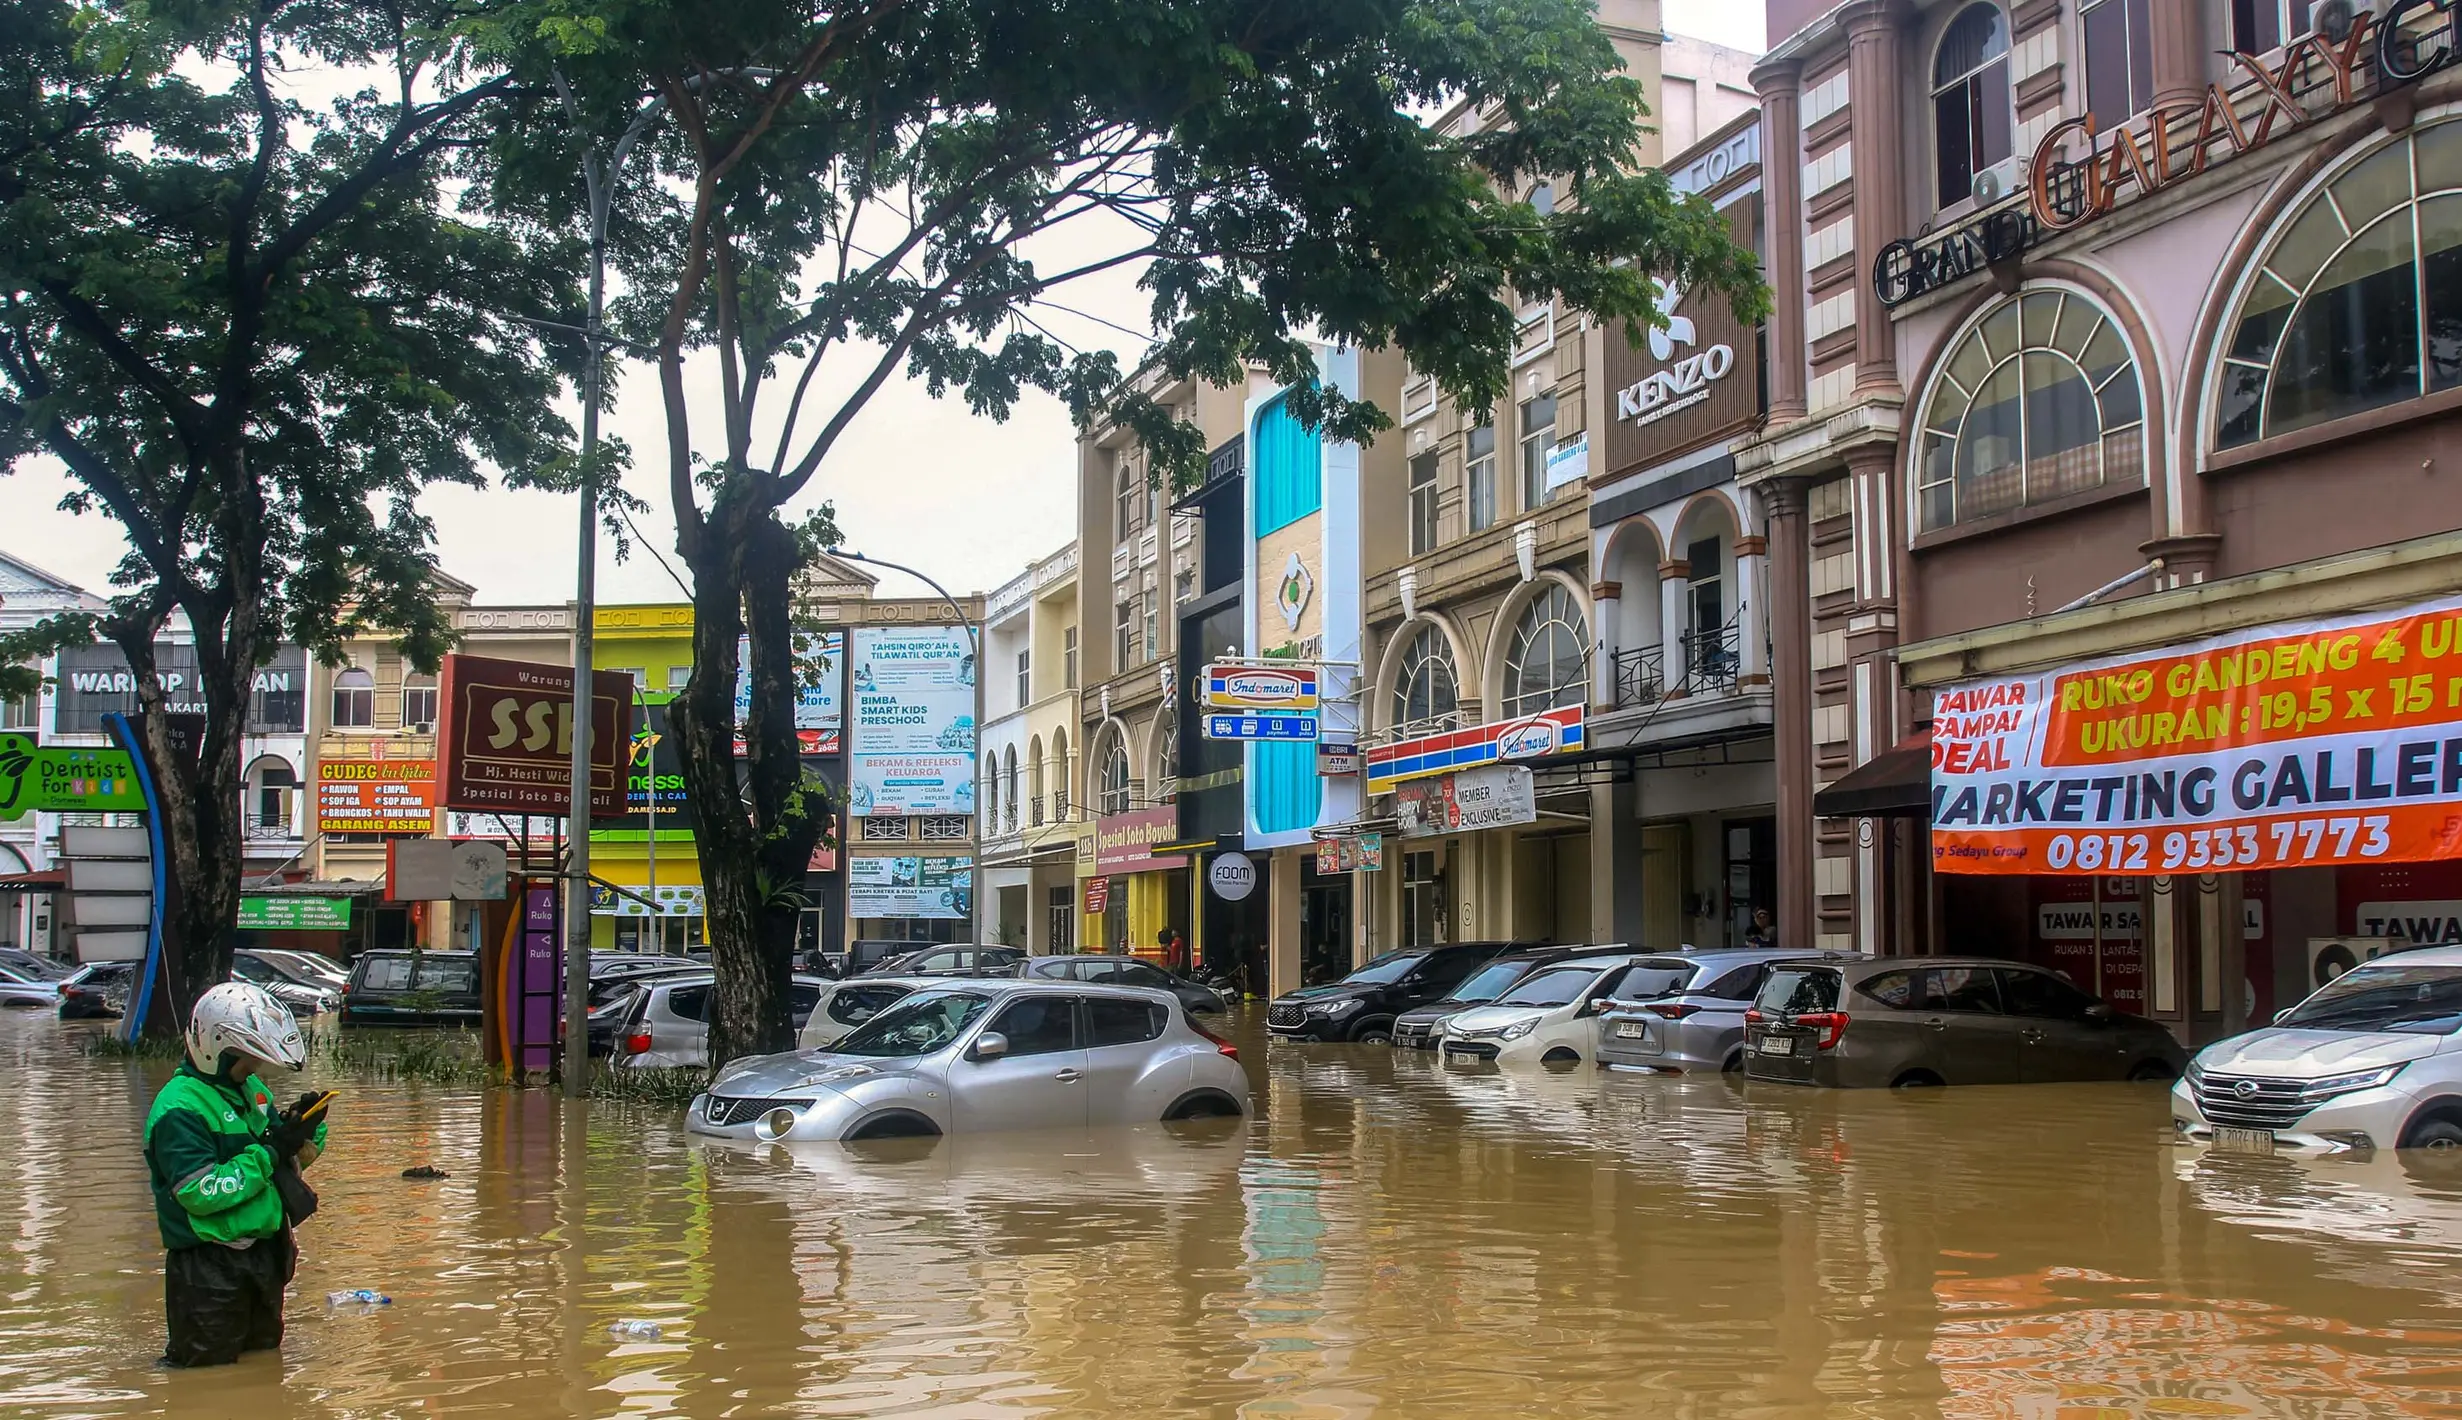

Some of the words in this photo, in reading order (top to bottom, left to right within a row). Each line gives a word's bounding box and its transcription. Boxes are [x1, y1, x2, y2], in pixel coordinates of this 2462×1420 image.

[1873, 209, 2033, 306] GRAND
[2030, 10, 2375, 230] GALAXY
[1617, 344, 1734, 421] KENZO
[953, 642, 960, 650] &
[871, 652, 921, 660] TILAWATIL
[922, 650, 960, 659] QUR'AN
[2060, 669, 2154, 713] RUKO
[2166, 635, 2361, 698] GANDENG
[2371, 627, 2406, 664] 4
[518, 671, 571, 688] Warung
[1231, 679, 1295, 694] Indomaret
[861, 696, 897, 704] BIMBA
[861, 706, 900, 715] SMART
[901, 705, 928, 714] KIDS
[2080, 702, 2231, 754] UKURAN
[2389, 672, 2434, 716] 15
[861, 716, 927, 725] PRESCHOOL
[1932, 709, 2023, 740] SAMPAI
[1502, 730, 1550, 755] Indomaret
[866, 759, 903, 767] BEKAM
[915, 758, 961, 766] REFLEKSI
[1329, 757, 1348, 765] ATM
[41, 760, 127, 778] Dentist
[322, 764, 377, 779] GUDEG
[486, 766, 504, 778] Hj.
[509, 768, 541, 780] Hesti
[886, 768, 941, 776] KELUARGA
[42, 779, 71, 793] for
[328, 785, 358, 794] RAWON
[383, 785, 409, 794] EMPAL
[463, 787, 512, 799] Spesial
[519, 789, 548, 801] Soto
[1459, 786, 1490, 803] MEMBER
[328, 797, 345, 806] SOP
[346, 797, 360, 806] IGA
[383, 797, 399, 806] SOP
[400, 797, 422, 806] AYAM
[1397, 800, 1421, 817] HAPPY
[328, 809, 372, 818] BRONGKOS
[383, 809, 404, 818] TAHU
[405, 809, 430, 818] WALIK
[1461, 808, 1501, 826] EXCLUSIVE
[320, 820, 384, 830] GARANG
[387, 820, 431, 830] ASEM
[1397, 815, 1417, 829] HOUR
[1098, 826, 1126, 853] Spesial
[1126, 824, 1144, 846] Soto
[2047, 832, 2151, 870] 0812
[2161, 824, 2261, 869] 9333
[2270, 814, 2391, 862] 7773
[1949, 844, 1989, 859] Sedayu
[1993, 845, 2027, 860] Group
[1216, 866, 1250, 880] FOOM
[531, 911, 552, 920] Ruko
[2042, 912, 2113, 930] TAWAR
[530, 949, 551, 958] Ruko
[2054, 944, 2086, 955] RUKAN
[2087, 944, 2094, 955] 3
[2105, 963, 2117, 974] DI
[2113, 989, 2136, 1000] 0812
[199, 1168, 246, 1196] Grab
